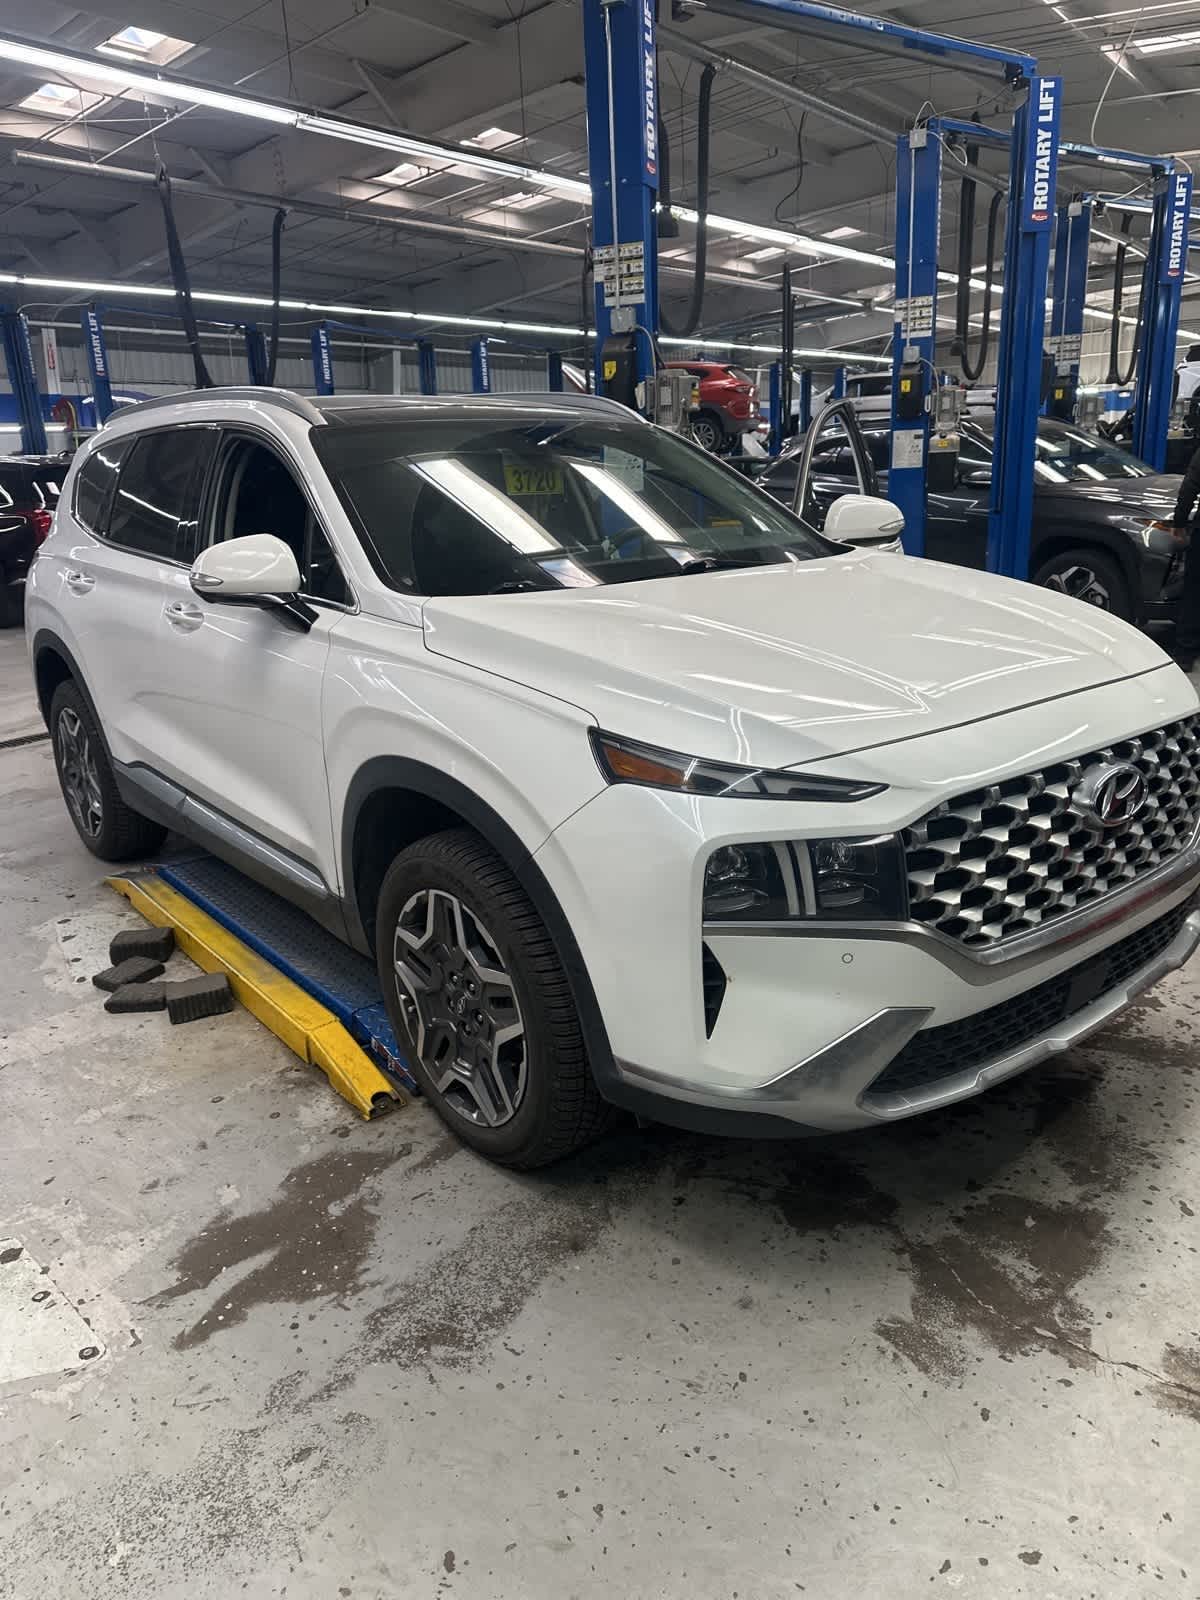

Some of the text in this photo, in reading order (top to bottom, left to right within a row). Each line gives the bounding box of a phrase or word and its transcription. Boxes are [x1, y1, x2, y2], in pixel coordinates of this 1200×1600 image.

[643, 0, 652, 45] LIF
[645, 49, 656, 160] ROTARY
[1038, 79, 1055, 122] LIFT
[1033, 128, 1052, 210] ROTARY
[1174, 175, 1188, 206] LIFT
[1169, 210, 1184, 269] ROTARY
[88, 312, 105, 372] ROTARY LIFT
[512, 469, 556, 491] 3720
